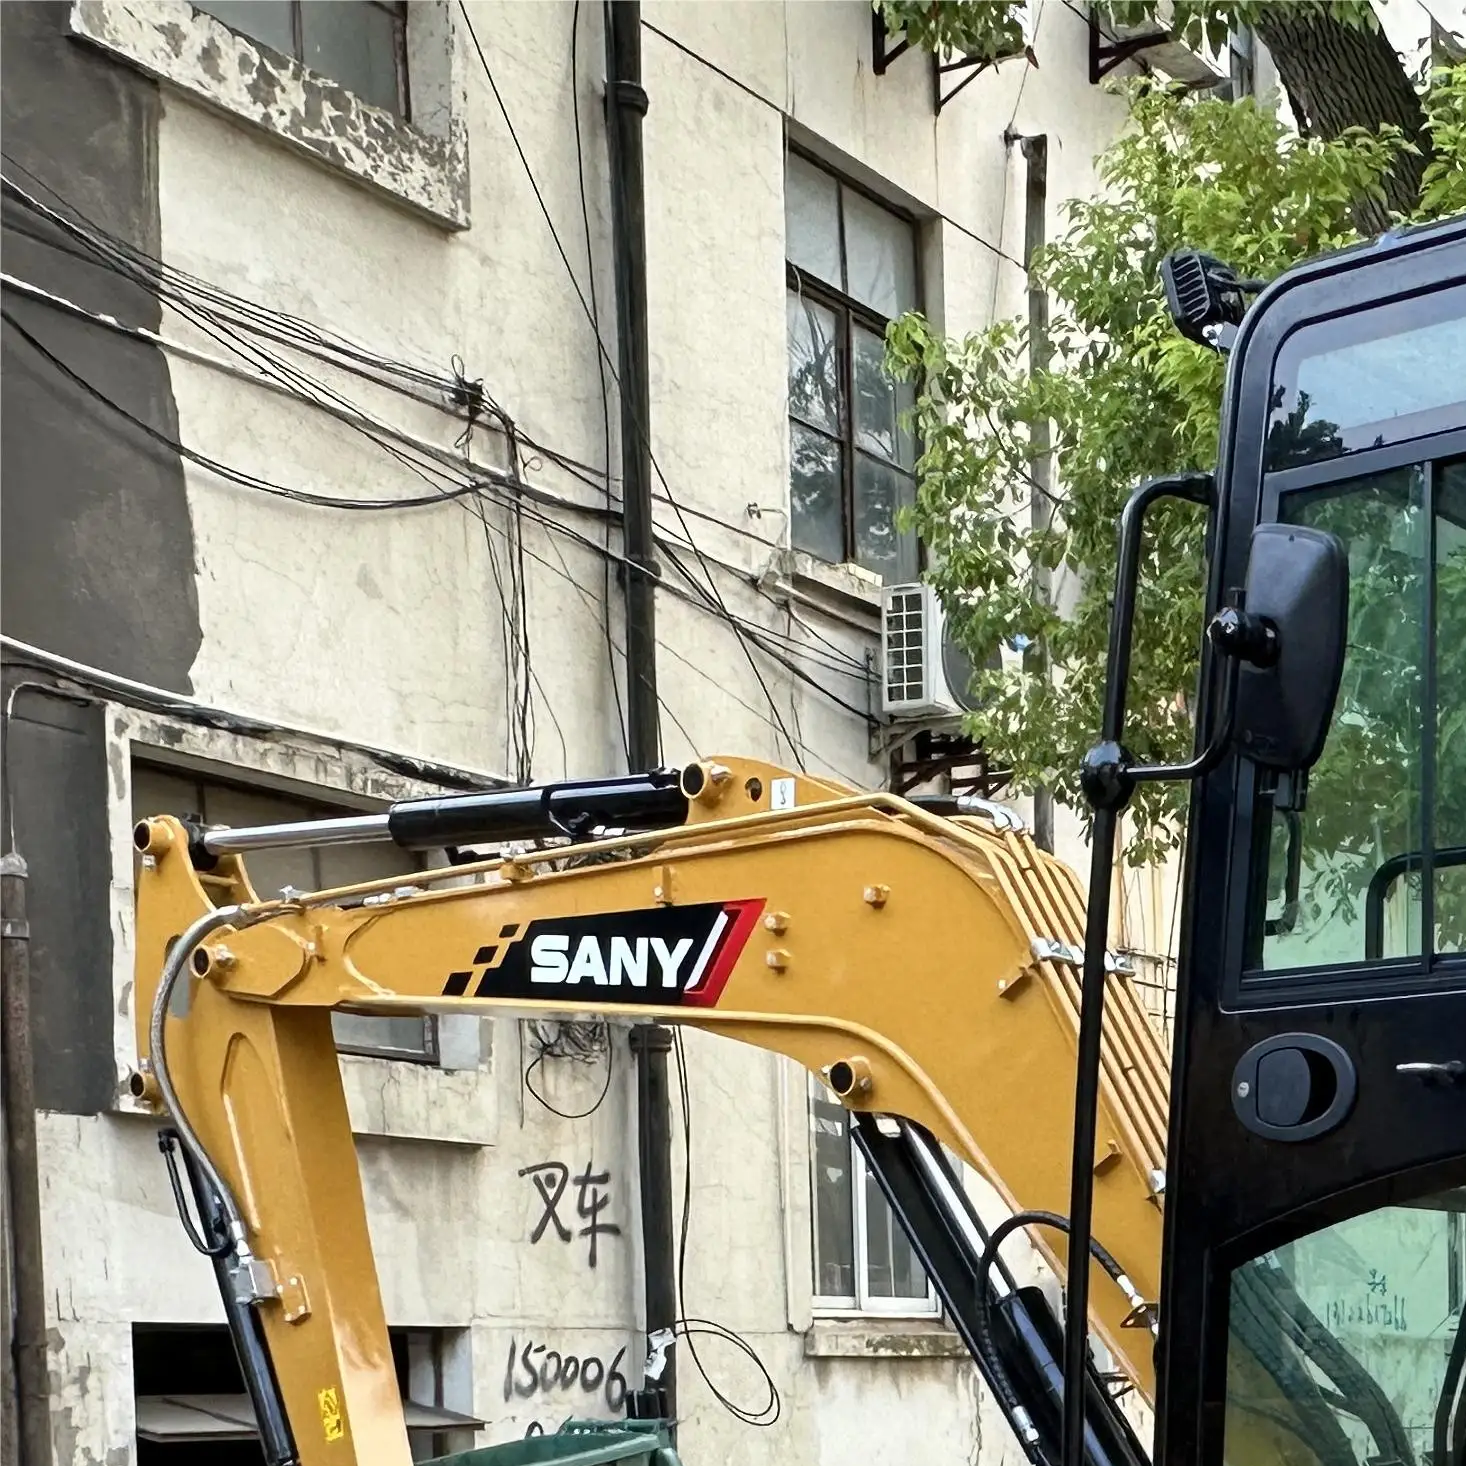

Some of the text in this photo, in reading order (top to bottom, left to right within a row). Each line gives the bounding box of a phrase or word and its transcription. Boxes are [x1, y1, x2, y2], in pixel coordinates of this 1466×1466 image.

[531, 934, 694, 988] SANY
[517, 1160, 622, 1269] 叉车
[503, 1335, 627, 1413] 150006
